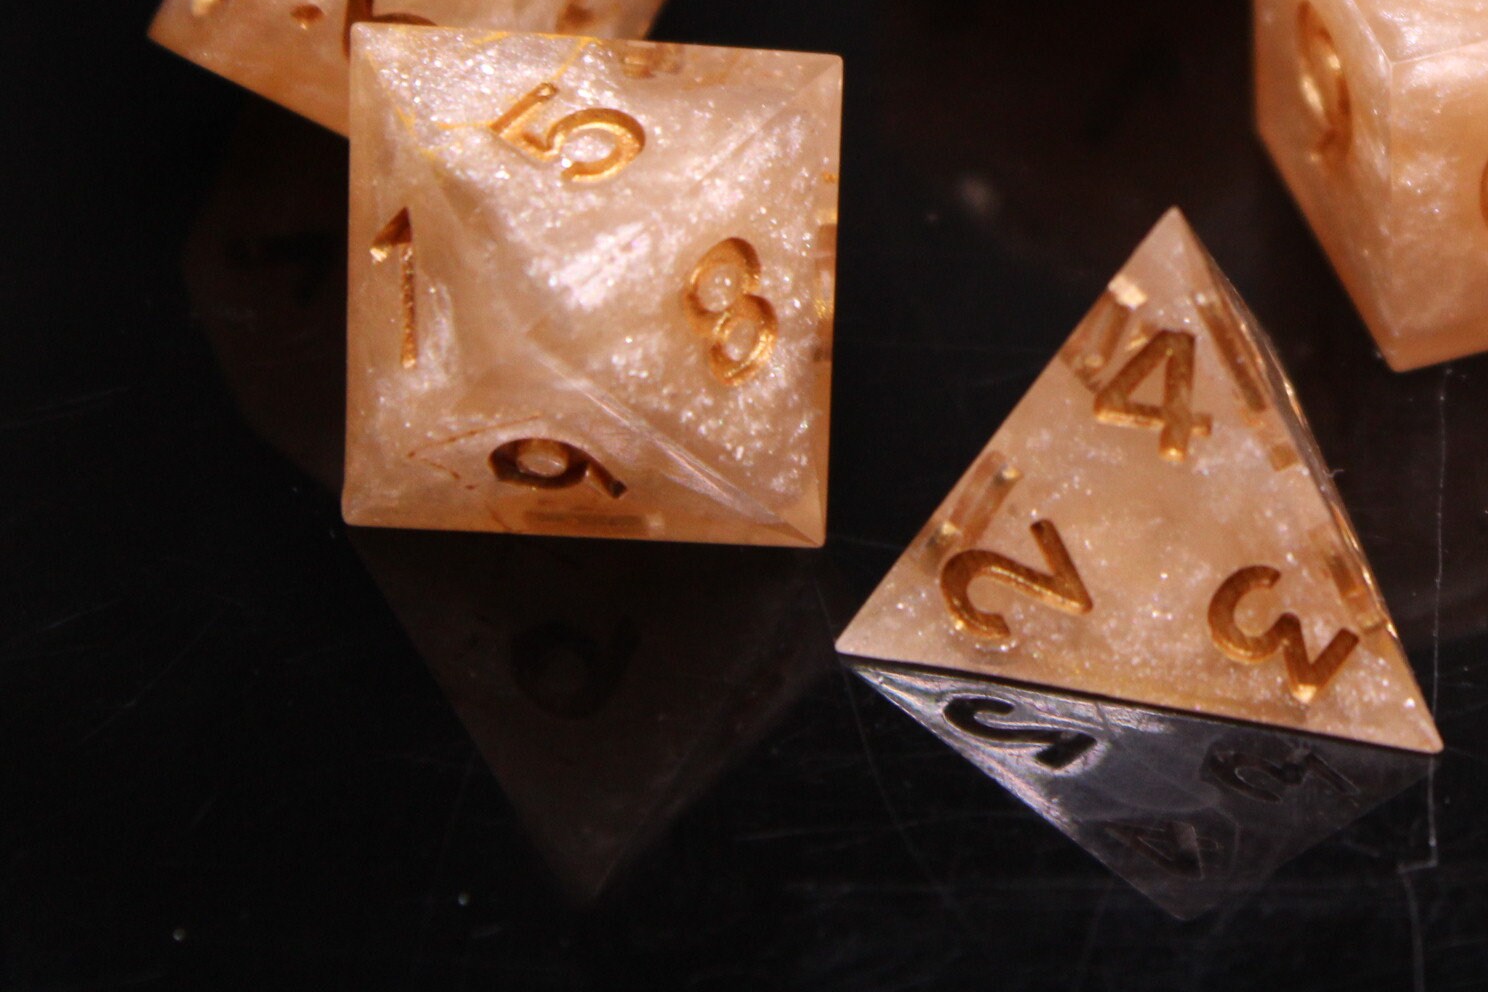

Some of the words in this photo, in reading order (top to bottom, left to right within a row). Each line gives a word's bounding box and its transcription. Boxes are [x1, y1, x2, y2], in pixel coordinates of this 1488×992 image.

[490, 81, 646, 182] 5
[370, 207, 416, 368] 1
[684, 236, 778, 387] 8
[1095, 329, 1211, 462] 4
[941, 518, 1094, 645] 2
[1207, 564, 1359, 705] 3
